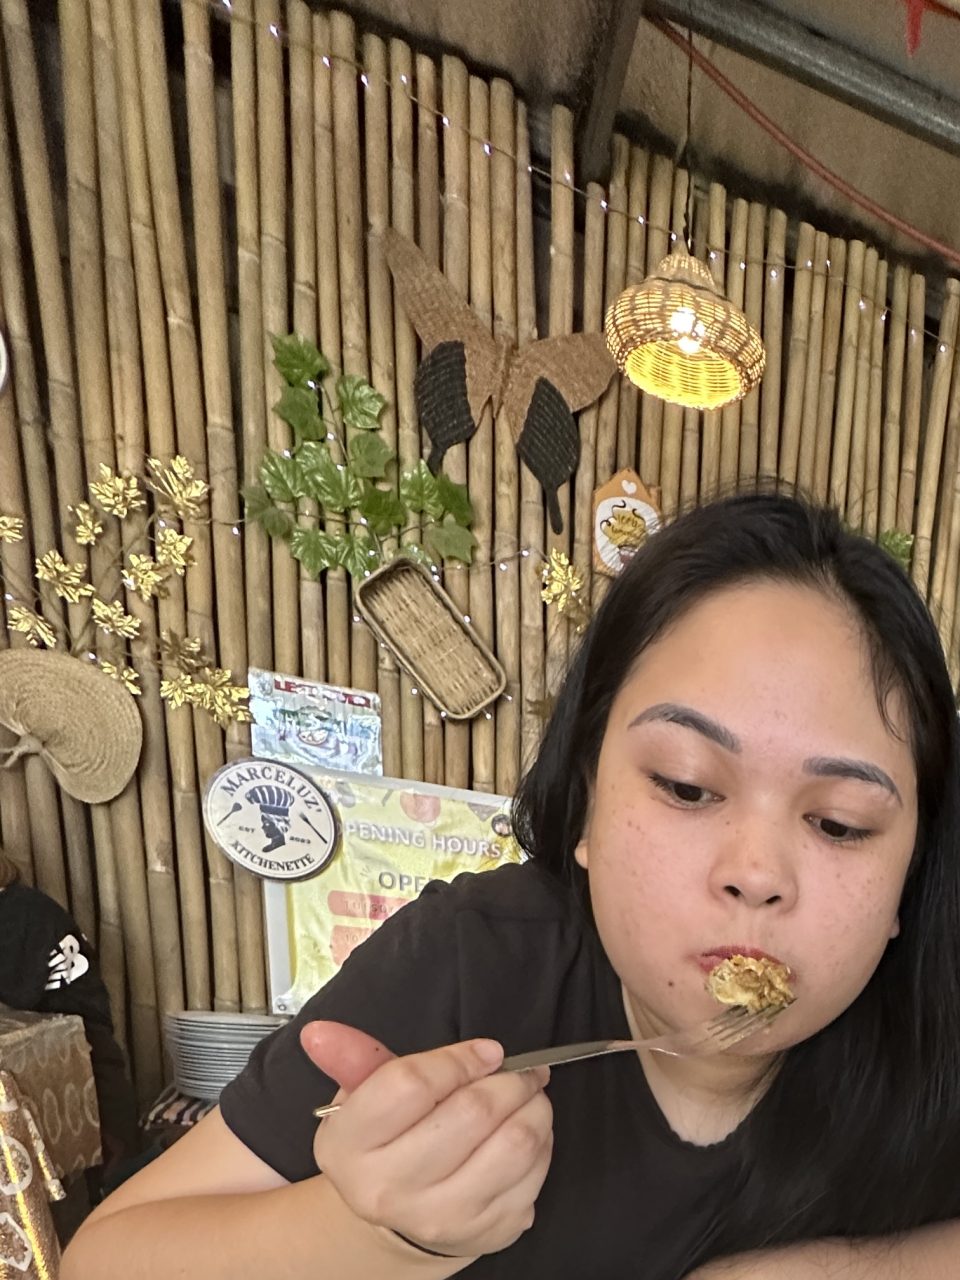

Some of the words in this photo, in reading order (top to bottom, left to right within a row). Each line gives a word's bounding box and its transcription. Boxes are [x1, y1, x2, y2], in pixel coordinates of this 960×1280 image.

[231, 840, 315, 872] KITCHENETTE
[346, 822, 425, 849] PENING
[432, 834, 502, 859] HOURS
[378, 872, 435, 893] OPE
